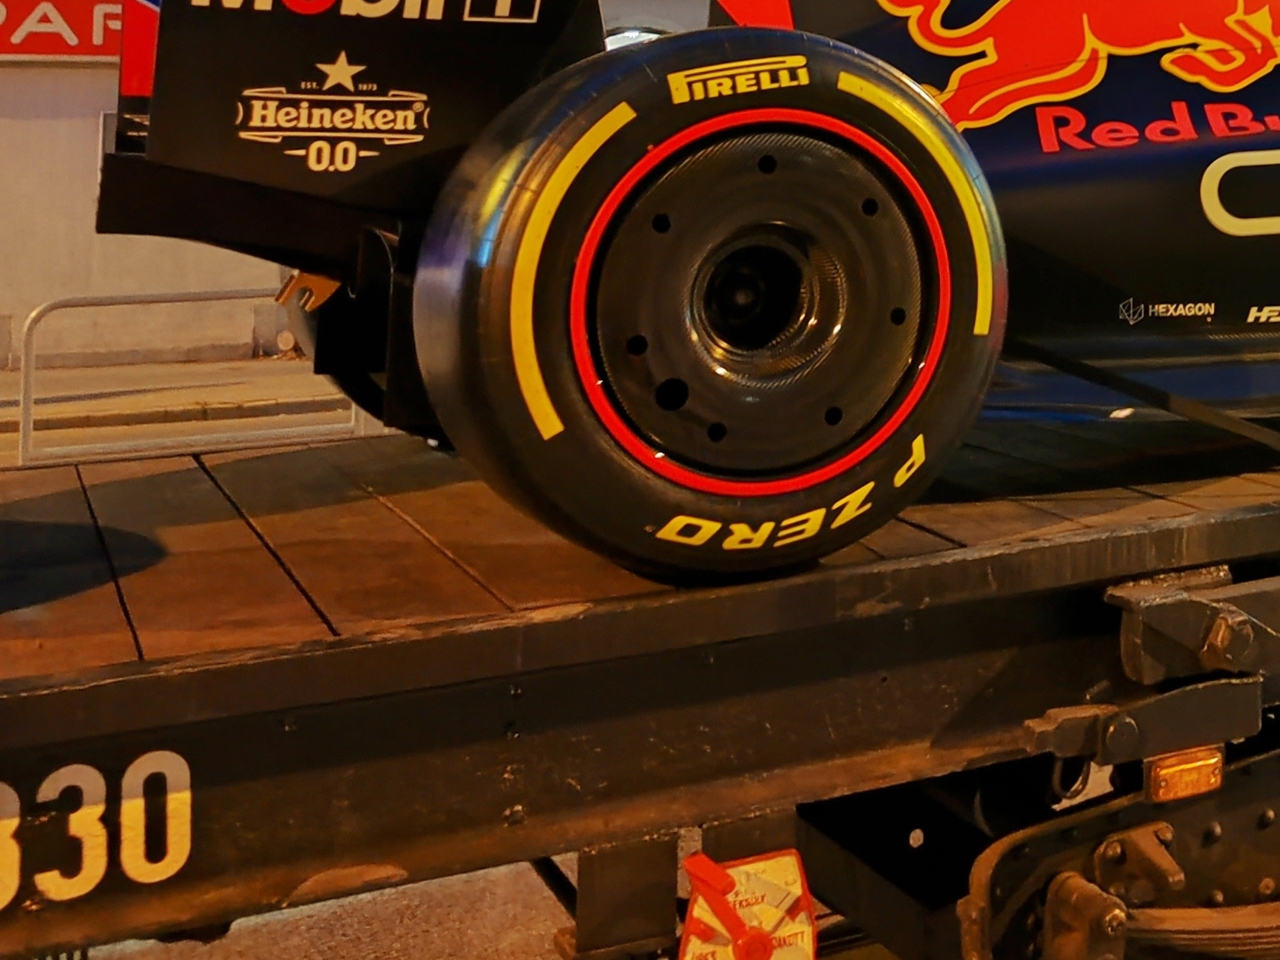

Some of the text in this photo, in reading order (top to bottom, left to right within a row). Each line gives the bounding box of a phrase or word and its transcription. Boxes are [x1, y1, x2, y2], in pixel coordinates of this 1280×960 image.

[0, 1, 122, 46] AR
[667, 55, 810, 104] PIRELLI
[248, 100, 417, 130] Heineken
[1035, 101, 1198, 153] Red
[307, 140, 357, 172] 0.0
[1149, 303, 1215, 316] HEXAGON
[656, 433, 926, 550] P ZERO
